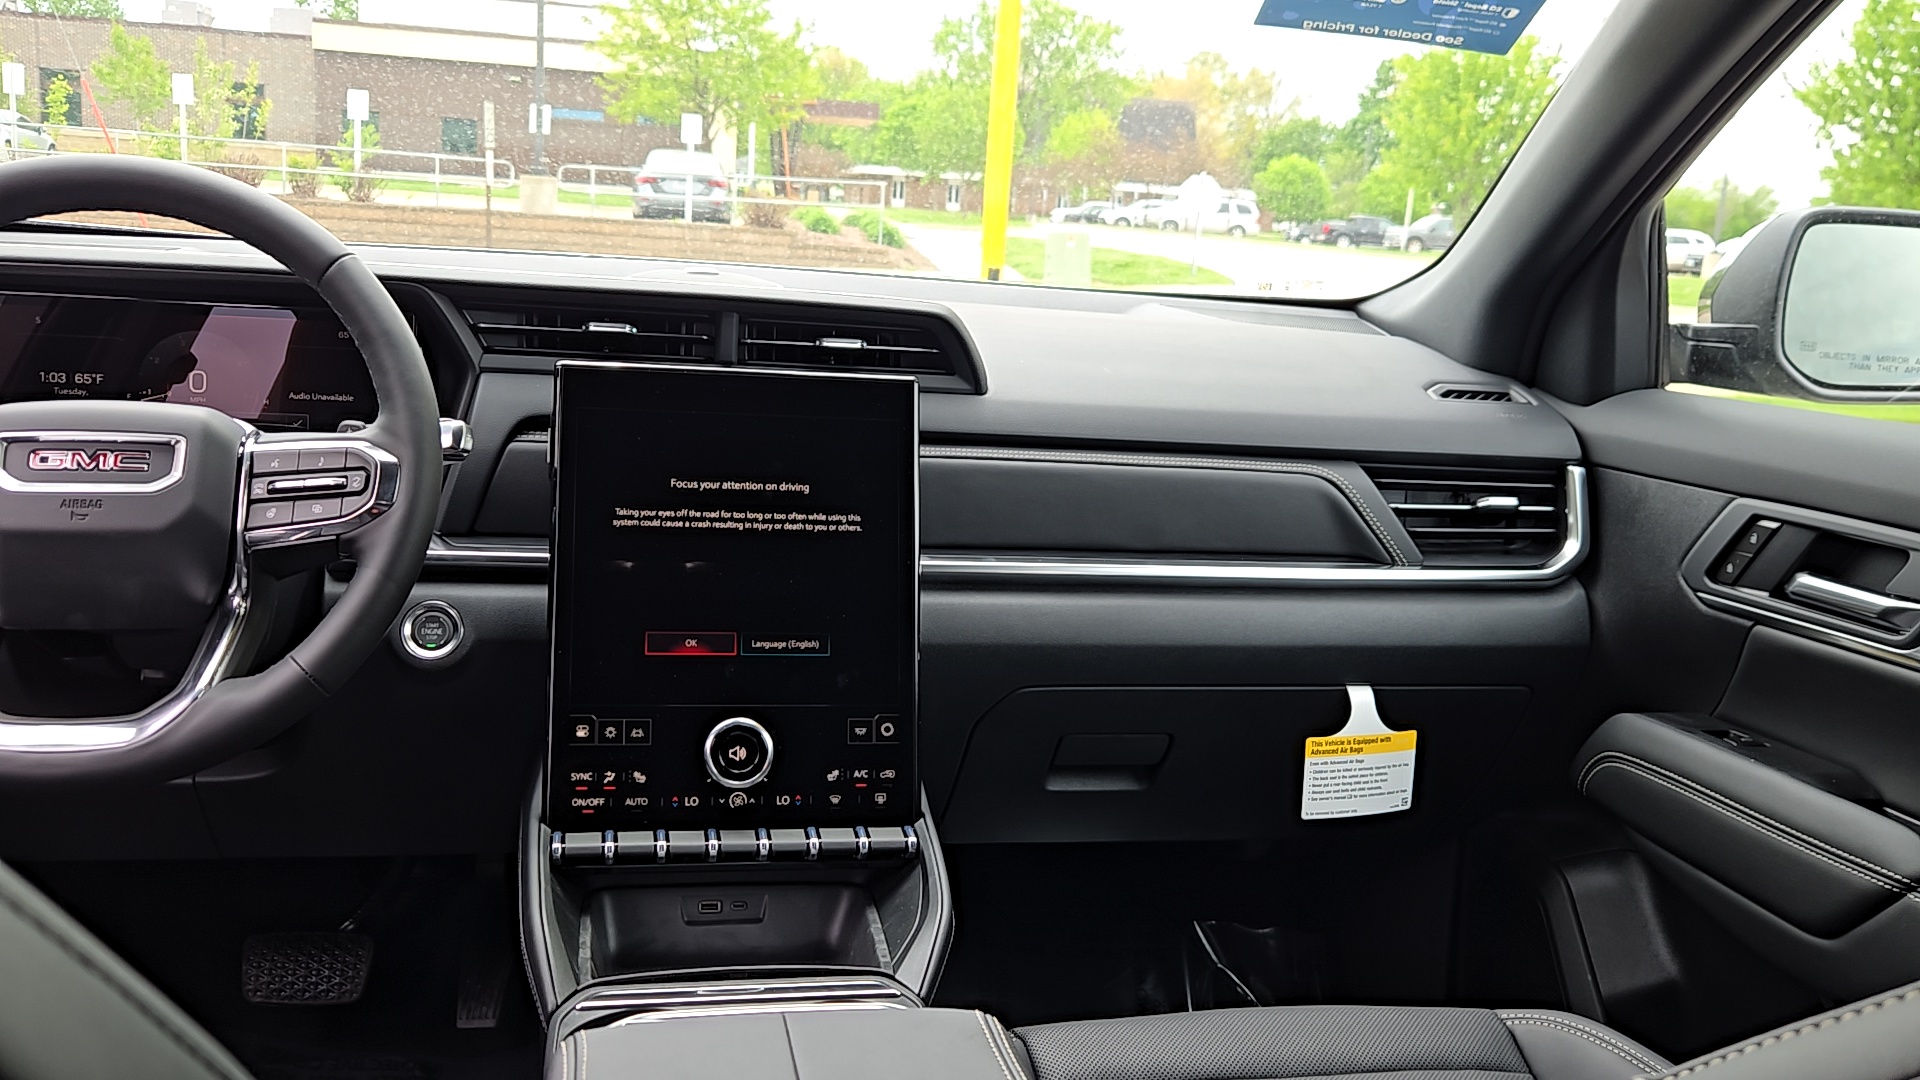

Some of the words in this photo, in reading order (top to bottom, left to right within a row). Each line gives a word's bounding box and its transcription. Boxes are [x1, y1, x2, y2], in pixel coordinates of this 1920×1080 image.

[1818, 351, 1856, 361] OBJECTS
[1861, 354, 1871, 362] IN
[1876, 355, 1909, 365] MIRROR
[1848, 362, 1872, 371] THAN
[1877, 364, 1900, 373] THEY
[38, 371, 67, 383] 1:03
[288, 391, 311, 401] Audio
[311, 392, 355, 402] Unavailable
[28, 449, 151, 471] GMC
[670, 477, 699, 489] Focus
[699, 481, 721, 491] your
[721, 480, 764, 491] attention
[764, 482, 778, 491] on
[778, 481, 810, 494] driving
[59, 498, 104, 509] AIRBAG
[614, 507, 640, 518] Taking
[639, 509, 657, 518] your
[657, 510, 676, 518] eyes
[676, 508, 689, 517] off
[689, 508, 701, 517] the
[702, 509, 720, 518] road
[720, 509, 732, 518] for
[732, 511, 746, 519] too
[746, 510, 763, 521] long
[773, 511, 787, 520] too
[787, 511, 807, 520] often
[807, 512, 827, 521] while
[827, 513, 847, 523] using
[847, 513, 862, 521] this
[612, 519, 640, 528] system
[640, 518, 661, 527] could
[661, 520, 684, 528] cause
[690, 519, 711, 528] crash
[712, 520, 744, 531] resulting
[752, 521, 773, 531] injury
[783, 521, 805, 530] death
[813, 524, 828, 532] you
[837, 523, 863, 532] others.
[420, 627, 443, 635] ENGINE
[684, 638, 698, 648] OK
[751, 639, 787, 650] Language
[787, 639, 820, 650] (English)
[1310, 740, 1323, 748] This
[1324, 739, 1345, 747] Vehicle
[1352, 737, 1378, 746] Equipped
[1310, 748, 1339, 756] Advanced
[1349, 746, 1364, 755] Bags
[570, 771, 593, 782] SYNC
[853, 768, 869, 779] A/C
[571, 797, 606, 808] ON/OFF
[624, 796, 649, 807] AUTO
[684, 796, 700, 807] LO
[775, 795, 791, 806] LO
